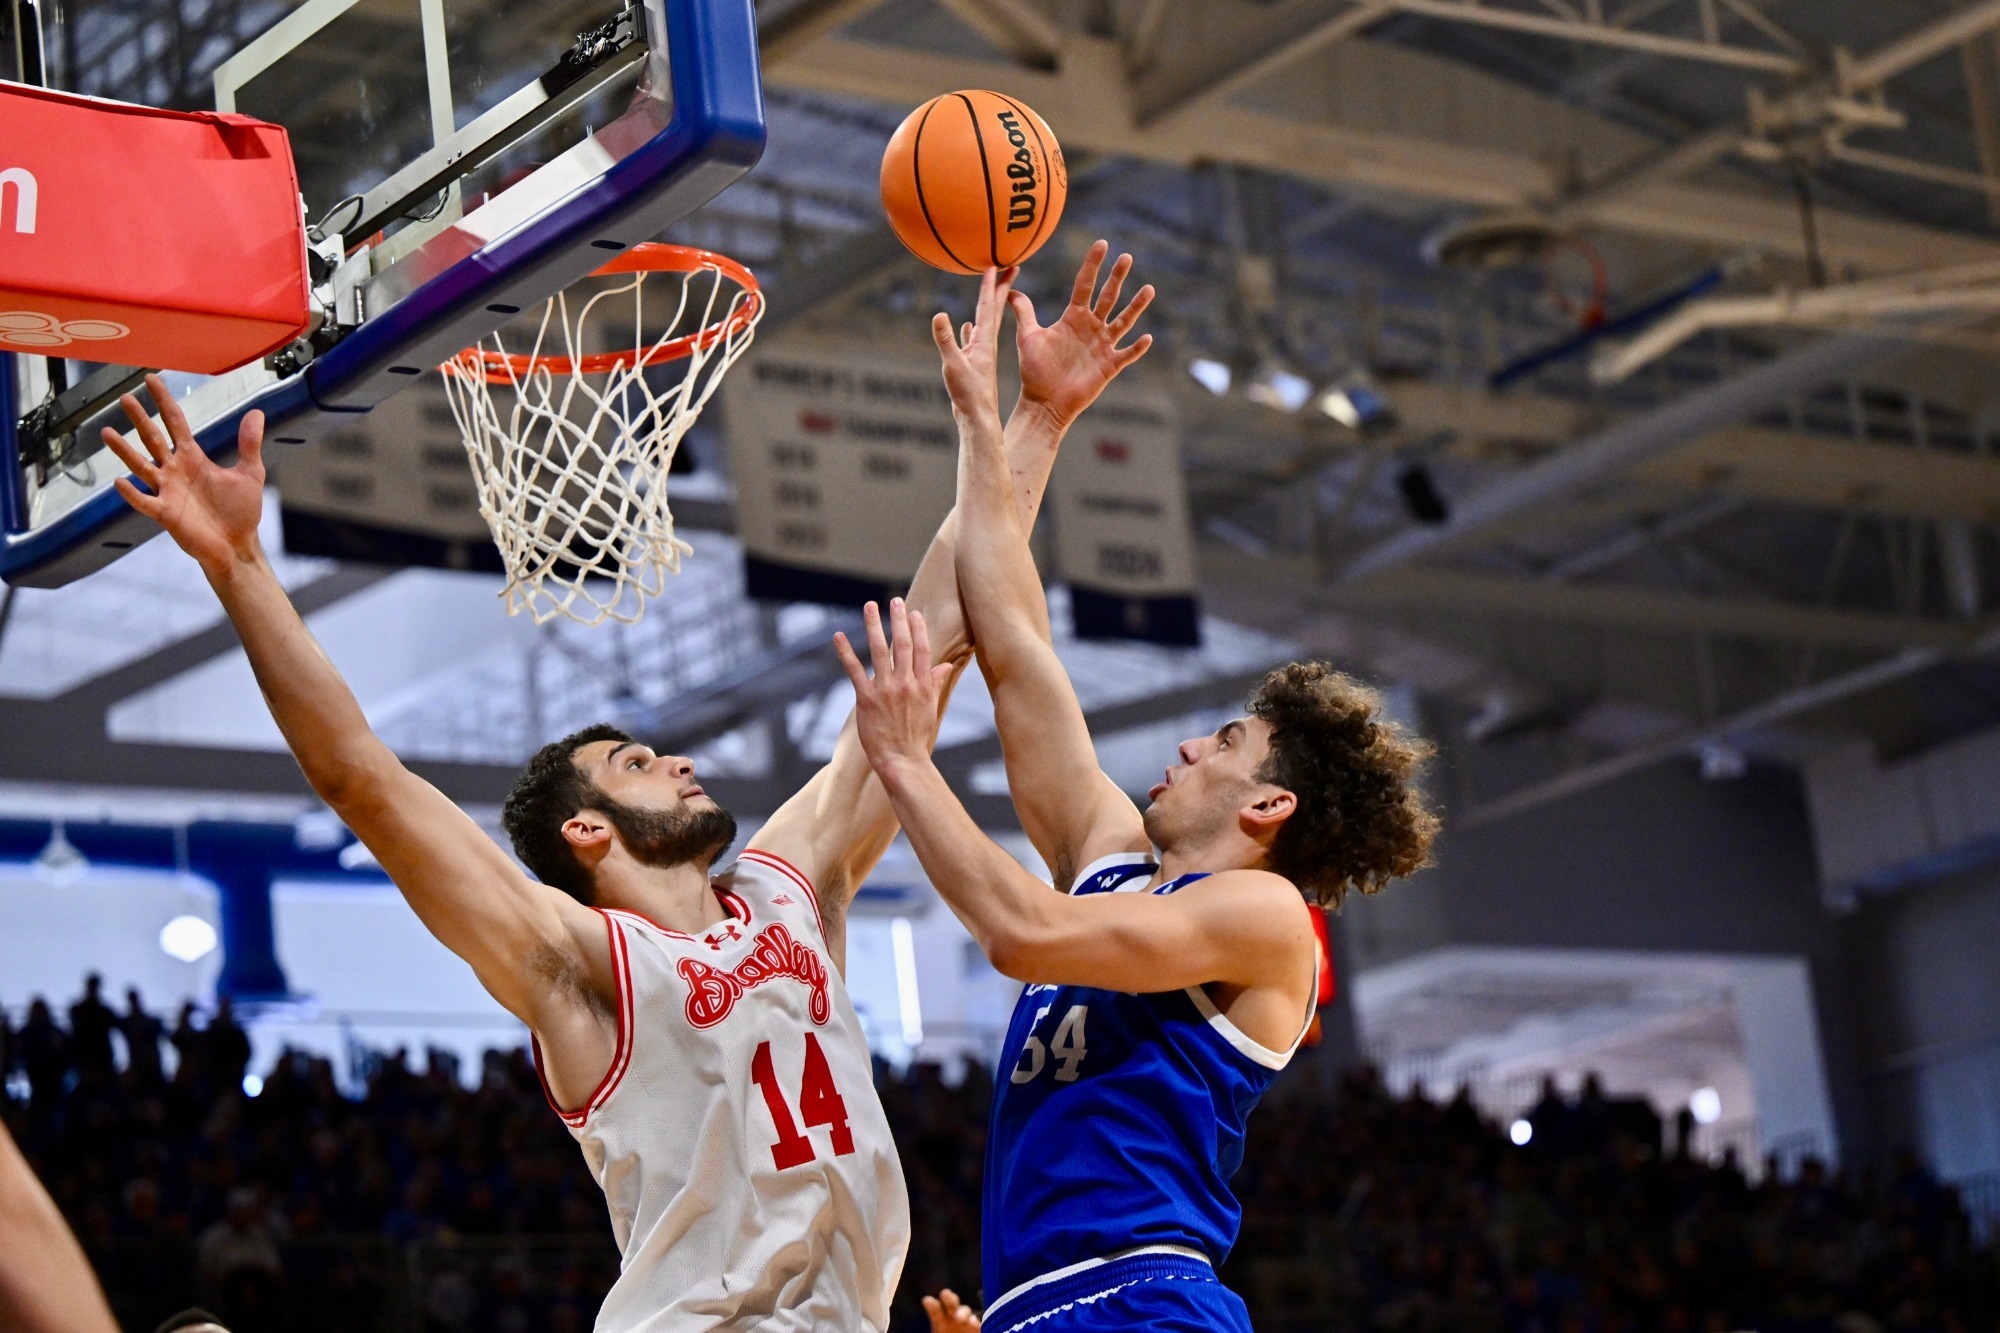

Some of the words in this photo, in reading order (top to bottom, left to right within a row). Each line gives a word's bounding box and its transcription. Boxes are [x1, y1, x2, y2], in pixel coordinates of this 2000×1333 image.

[997, 110, 1036, 233] Wilson
[676, 922, 830, 1029] Bradley
[751, 1032, 856, 1171] 14
